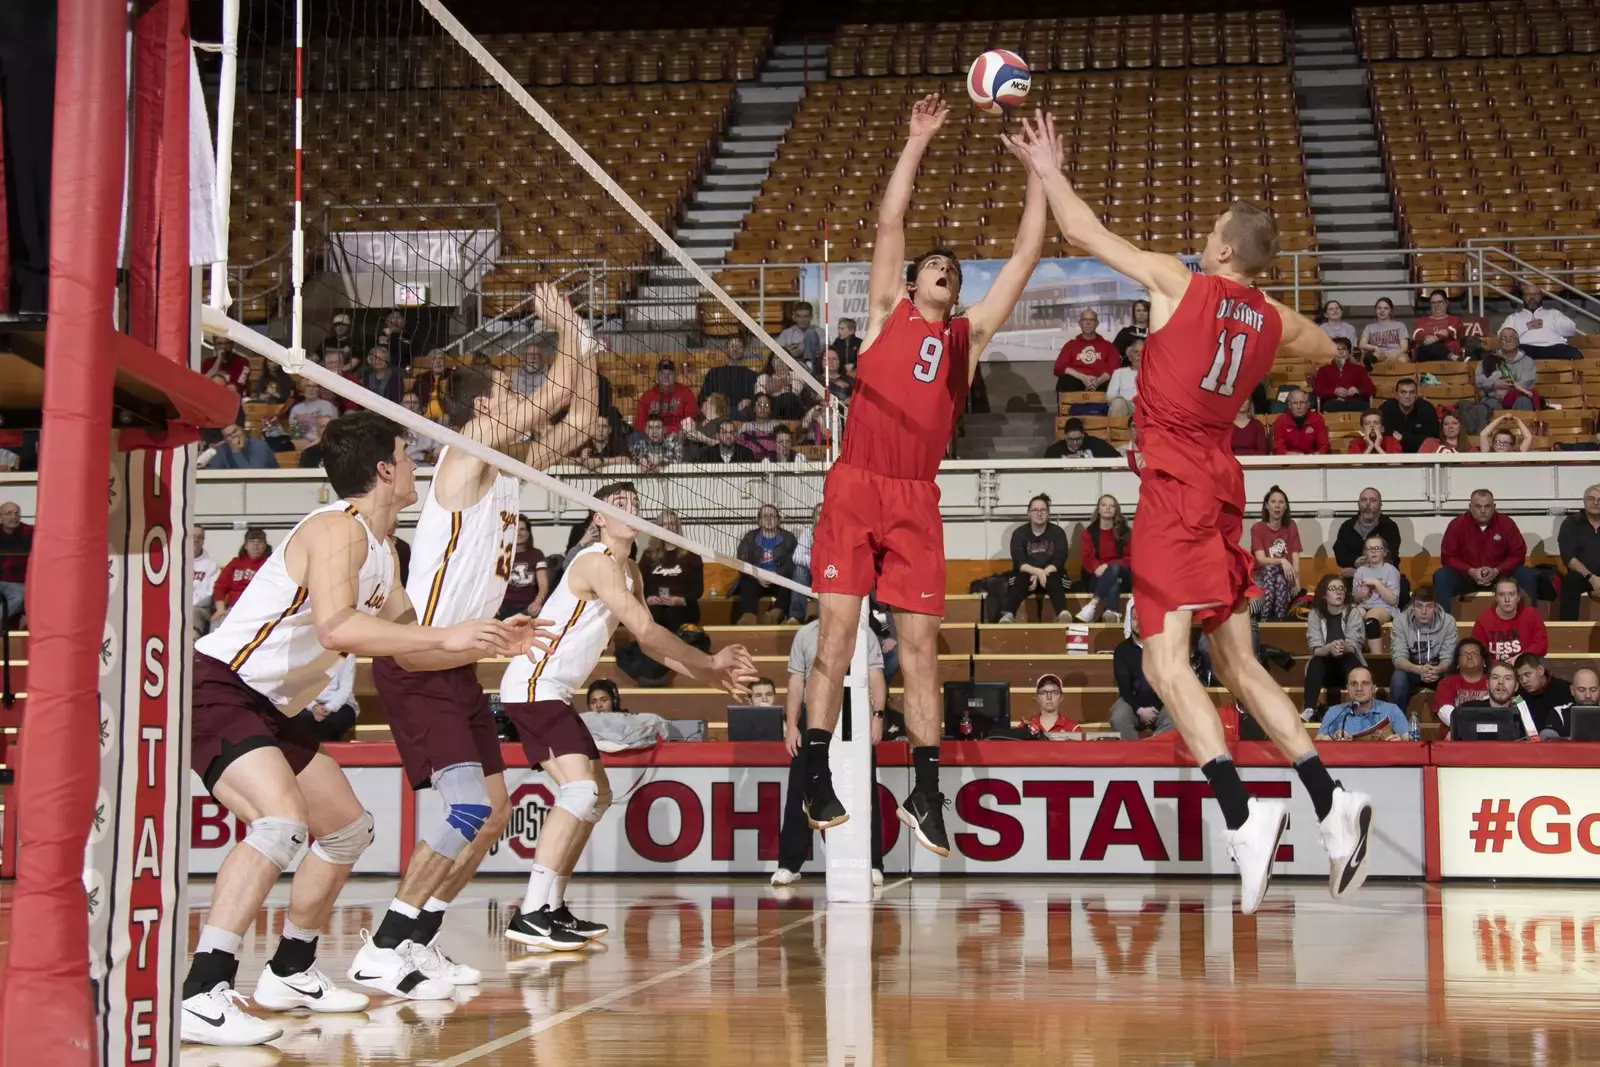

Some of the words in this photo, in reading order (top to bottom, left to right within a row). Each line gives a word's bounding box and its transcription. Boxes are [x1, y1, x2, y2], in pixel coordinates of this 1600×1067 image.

[1463, 322, 1484, 337] 7A
[912, 335, 944, 383] 9
[1199, 327, 1248, 397] 11
[1488, 639, 1522, 655] LESS
